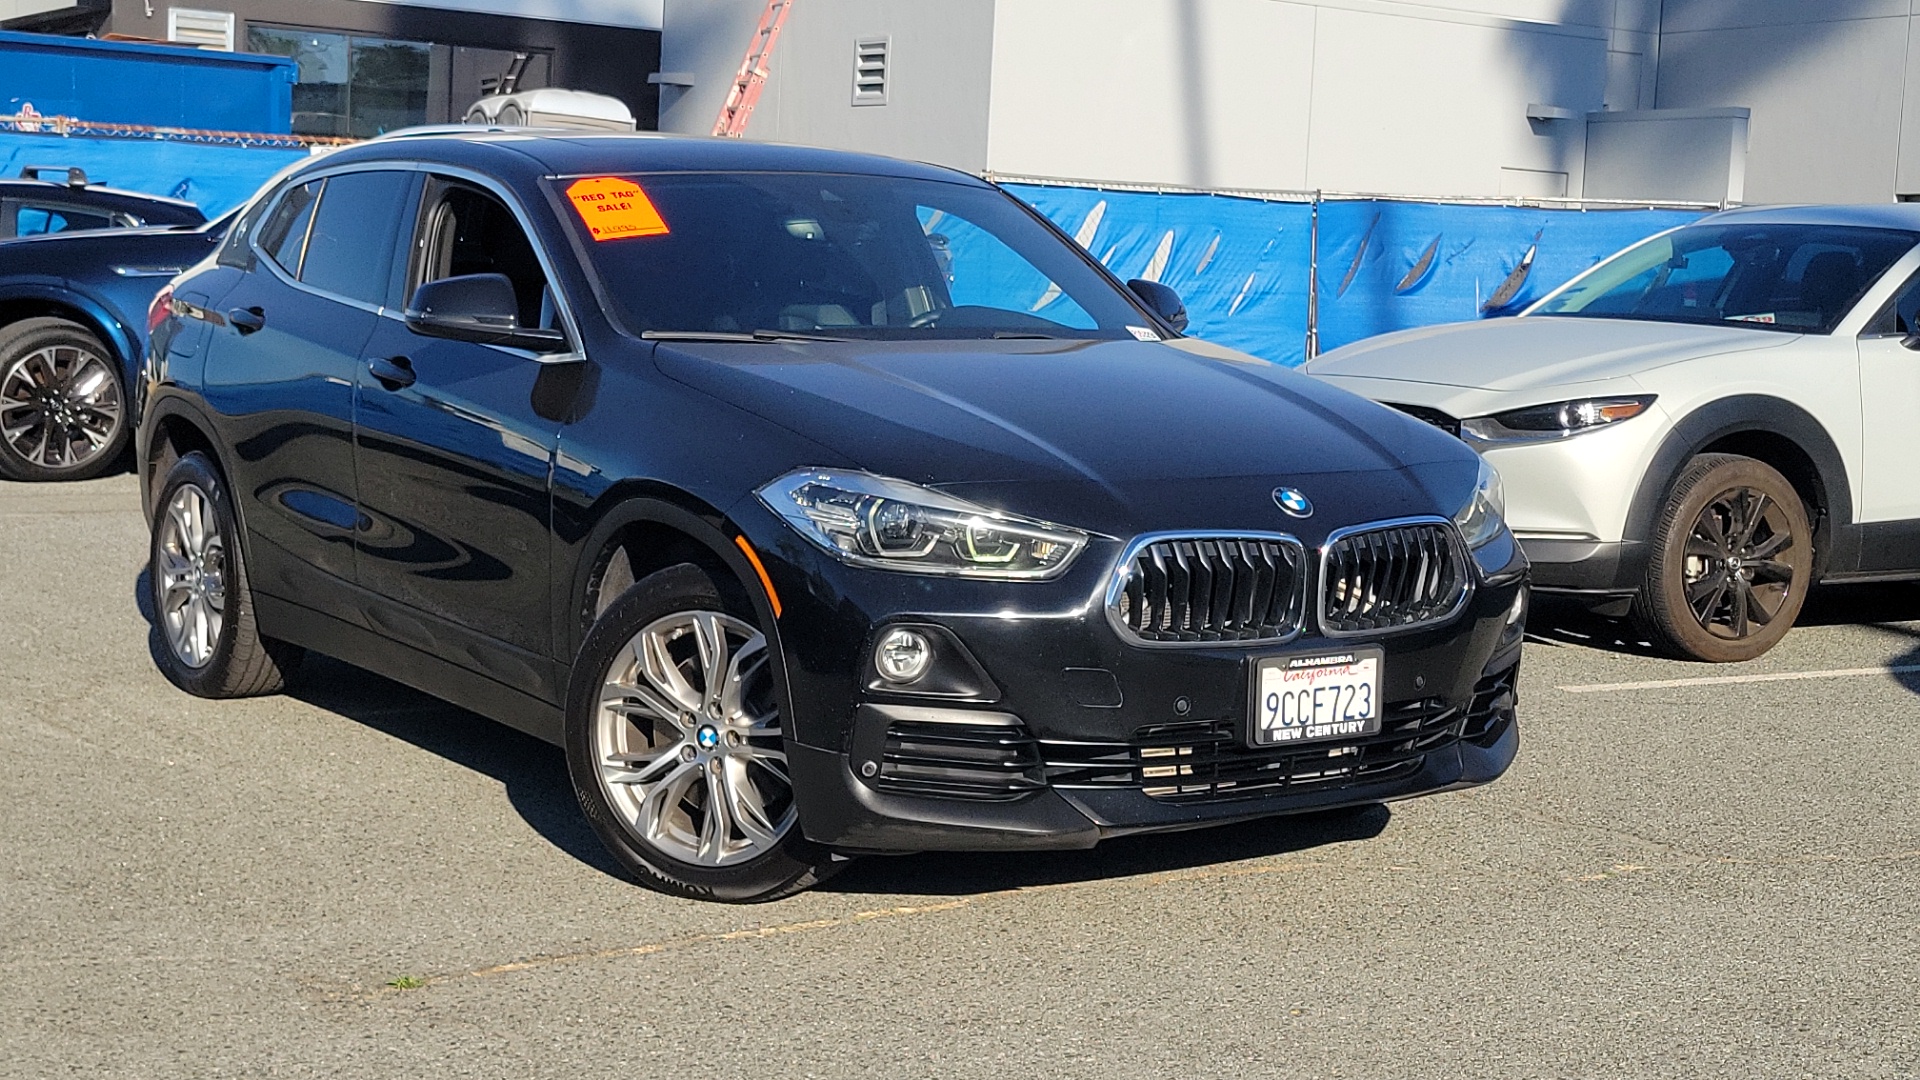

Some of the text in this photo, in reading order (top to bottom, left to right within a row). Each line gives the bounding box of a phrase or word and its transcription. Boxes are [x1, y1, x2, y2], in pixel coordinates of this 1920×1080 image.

[597, 202, 633, 212] SALE!
[1289, 654, 1353, 668] ALHAMBRA
[1283, 665, 1358, 686] California
[1266, 682, 1371, 729] 9CCF723
[1272, 720, 1366, 742] NEW CENTURY
